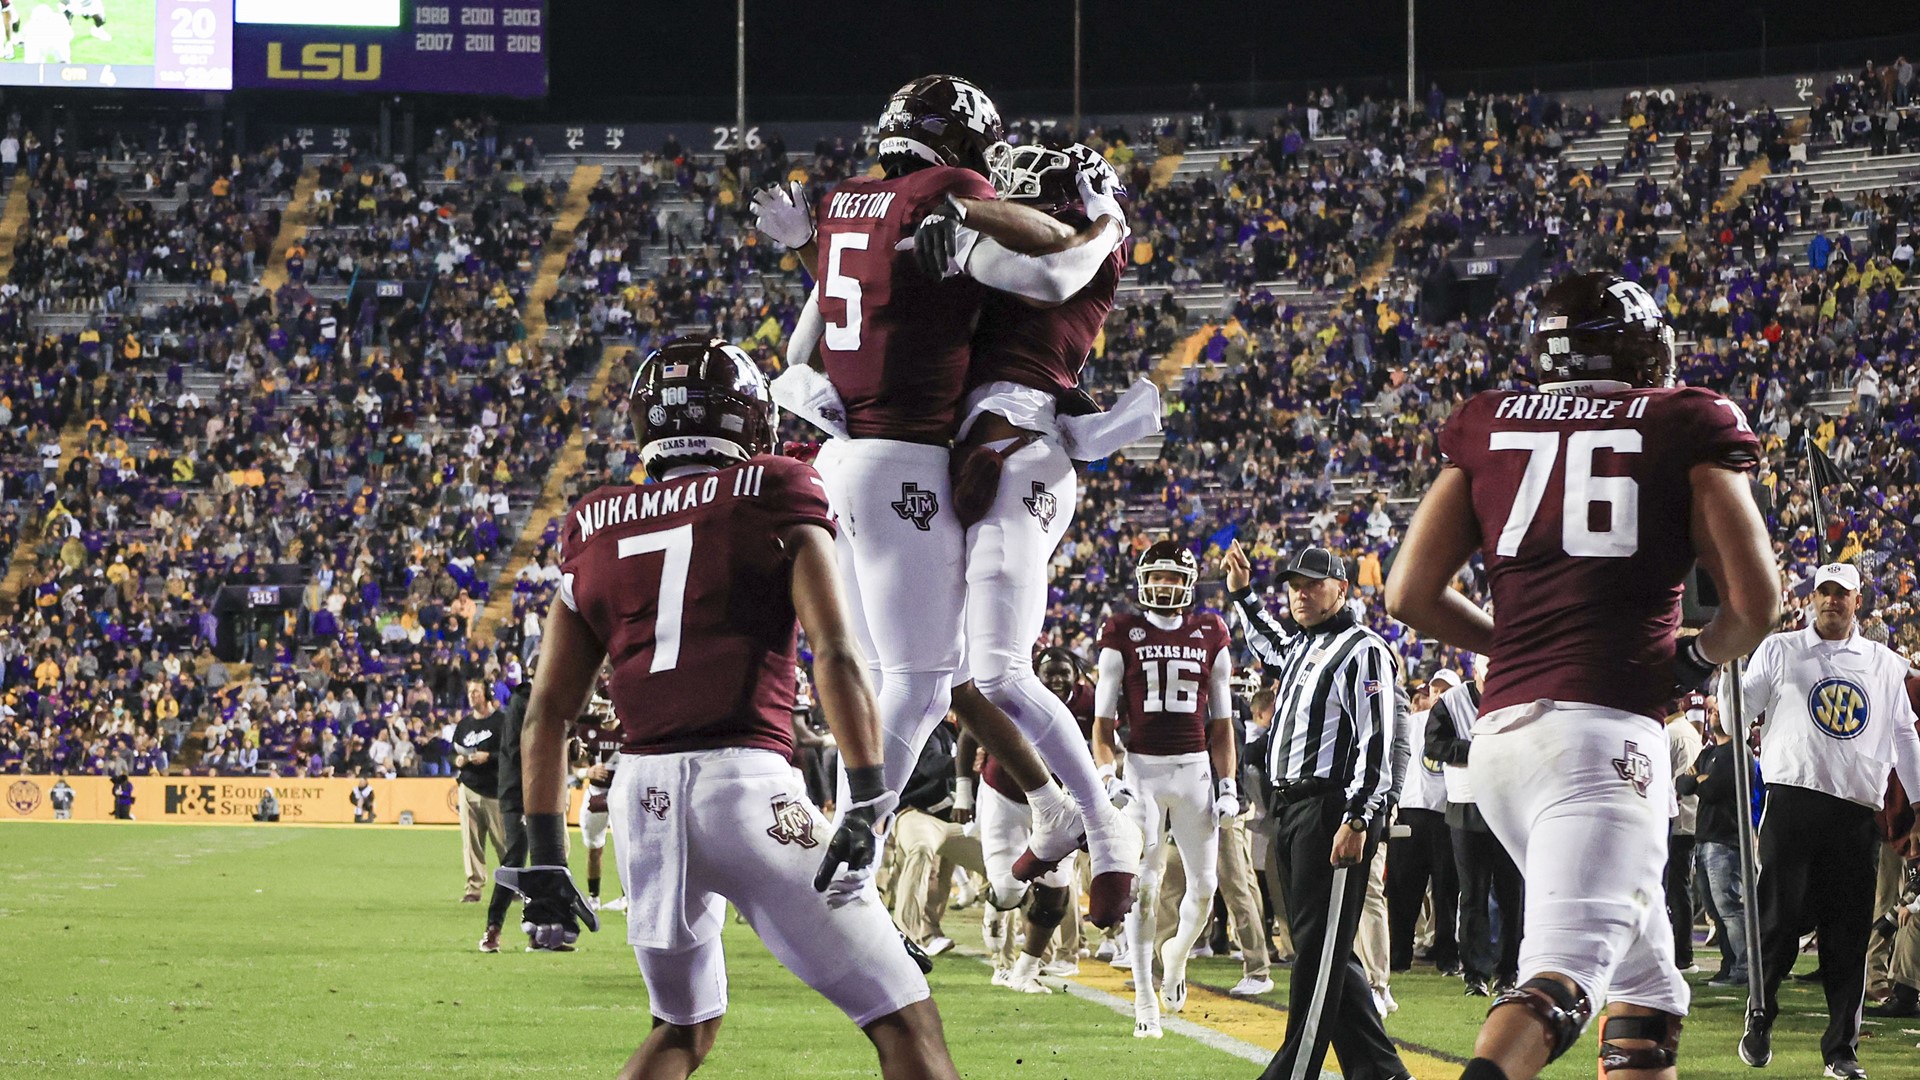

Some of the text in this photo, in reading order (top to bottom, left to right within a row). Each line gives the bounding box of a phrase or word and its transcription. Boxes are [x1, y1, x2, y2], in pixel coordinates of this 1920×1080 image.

[416, 7, 541, 26] 1988 2001 2003
[416, 33, 541, 52] 2007 2011 2019
[267, 42, 382, 80] LSU
[1796, 78, 1813, 89] 239
[828, 191, 896, 219] PRESTON
[825, 232, 870, 351] 5
[1495, 396, 1649, 420] FATHEREE II
[658, 439, 685, 452] TEXAS
[576, 465, 764, 542] MUHAMMAD III
[1489, 429, 1643, 558] 76
[253, 591, 272, 604] 215
[618, 523, 693, 674] 7
[1135, 645, 1181, 660] TEXAS
[1142, 660, 1201, 713] 16
[1691, 696, 1704, 705] 90
[1816, 684, 1864, 732] SEC
[221, 784, 324, 800] EQUIMENT
